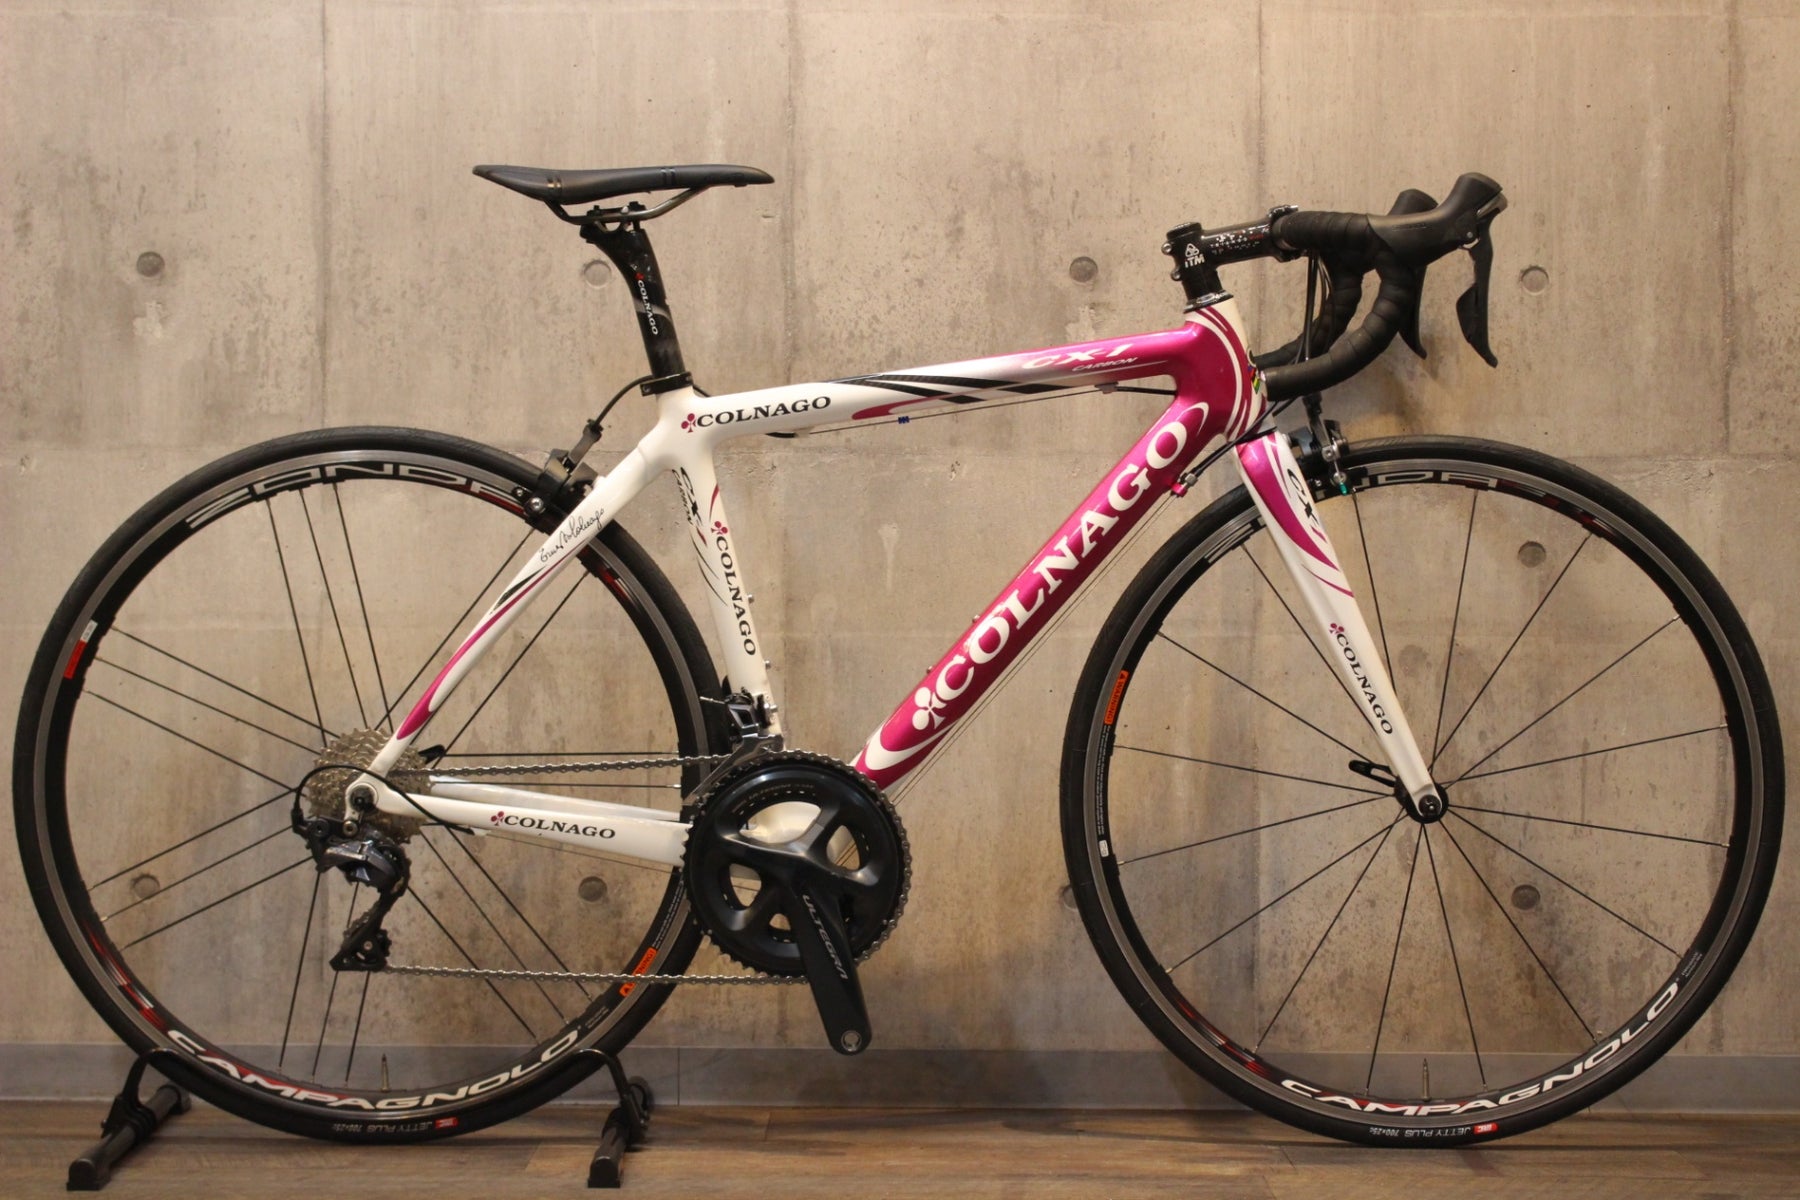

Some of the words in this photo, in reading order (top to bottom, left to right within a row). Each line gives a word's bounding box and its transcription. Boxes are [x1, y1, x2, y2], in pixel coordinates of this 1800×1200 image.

[637, 280, 658, 335] COLNAGO
[1072, 356, 1138, 371] CARBON
[697, 396, 831, 428] COLNAGO
[936, 421, 1187, 701] COLNAGO
[716, 536, 756, 656] COLNAGO
[1337, 633, 1393, 734] COLNAGO
[504, 815, 616, 839] COLNAGO
[167, 1028, 580, 1111] CAMPAGNOLO
[1281, 982, 1678, 1117] CAMPAGNOLO
[1404, 1130, 1434, 1138] PLUS
[1436, 1126, 1471, 1136] JETTY
